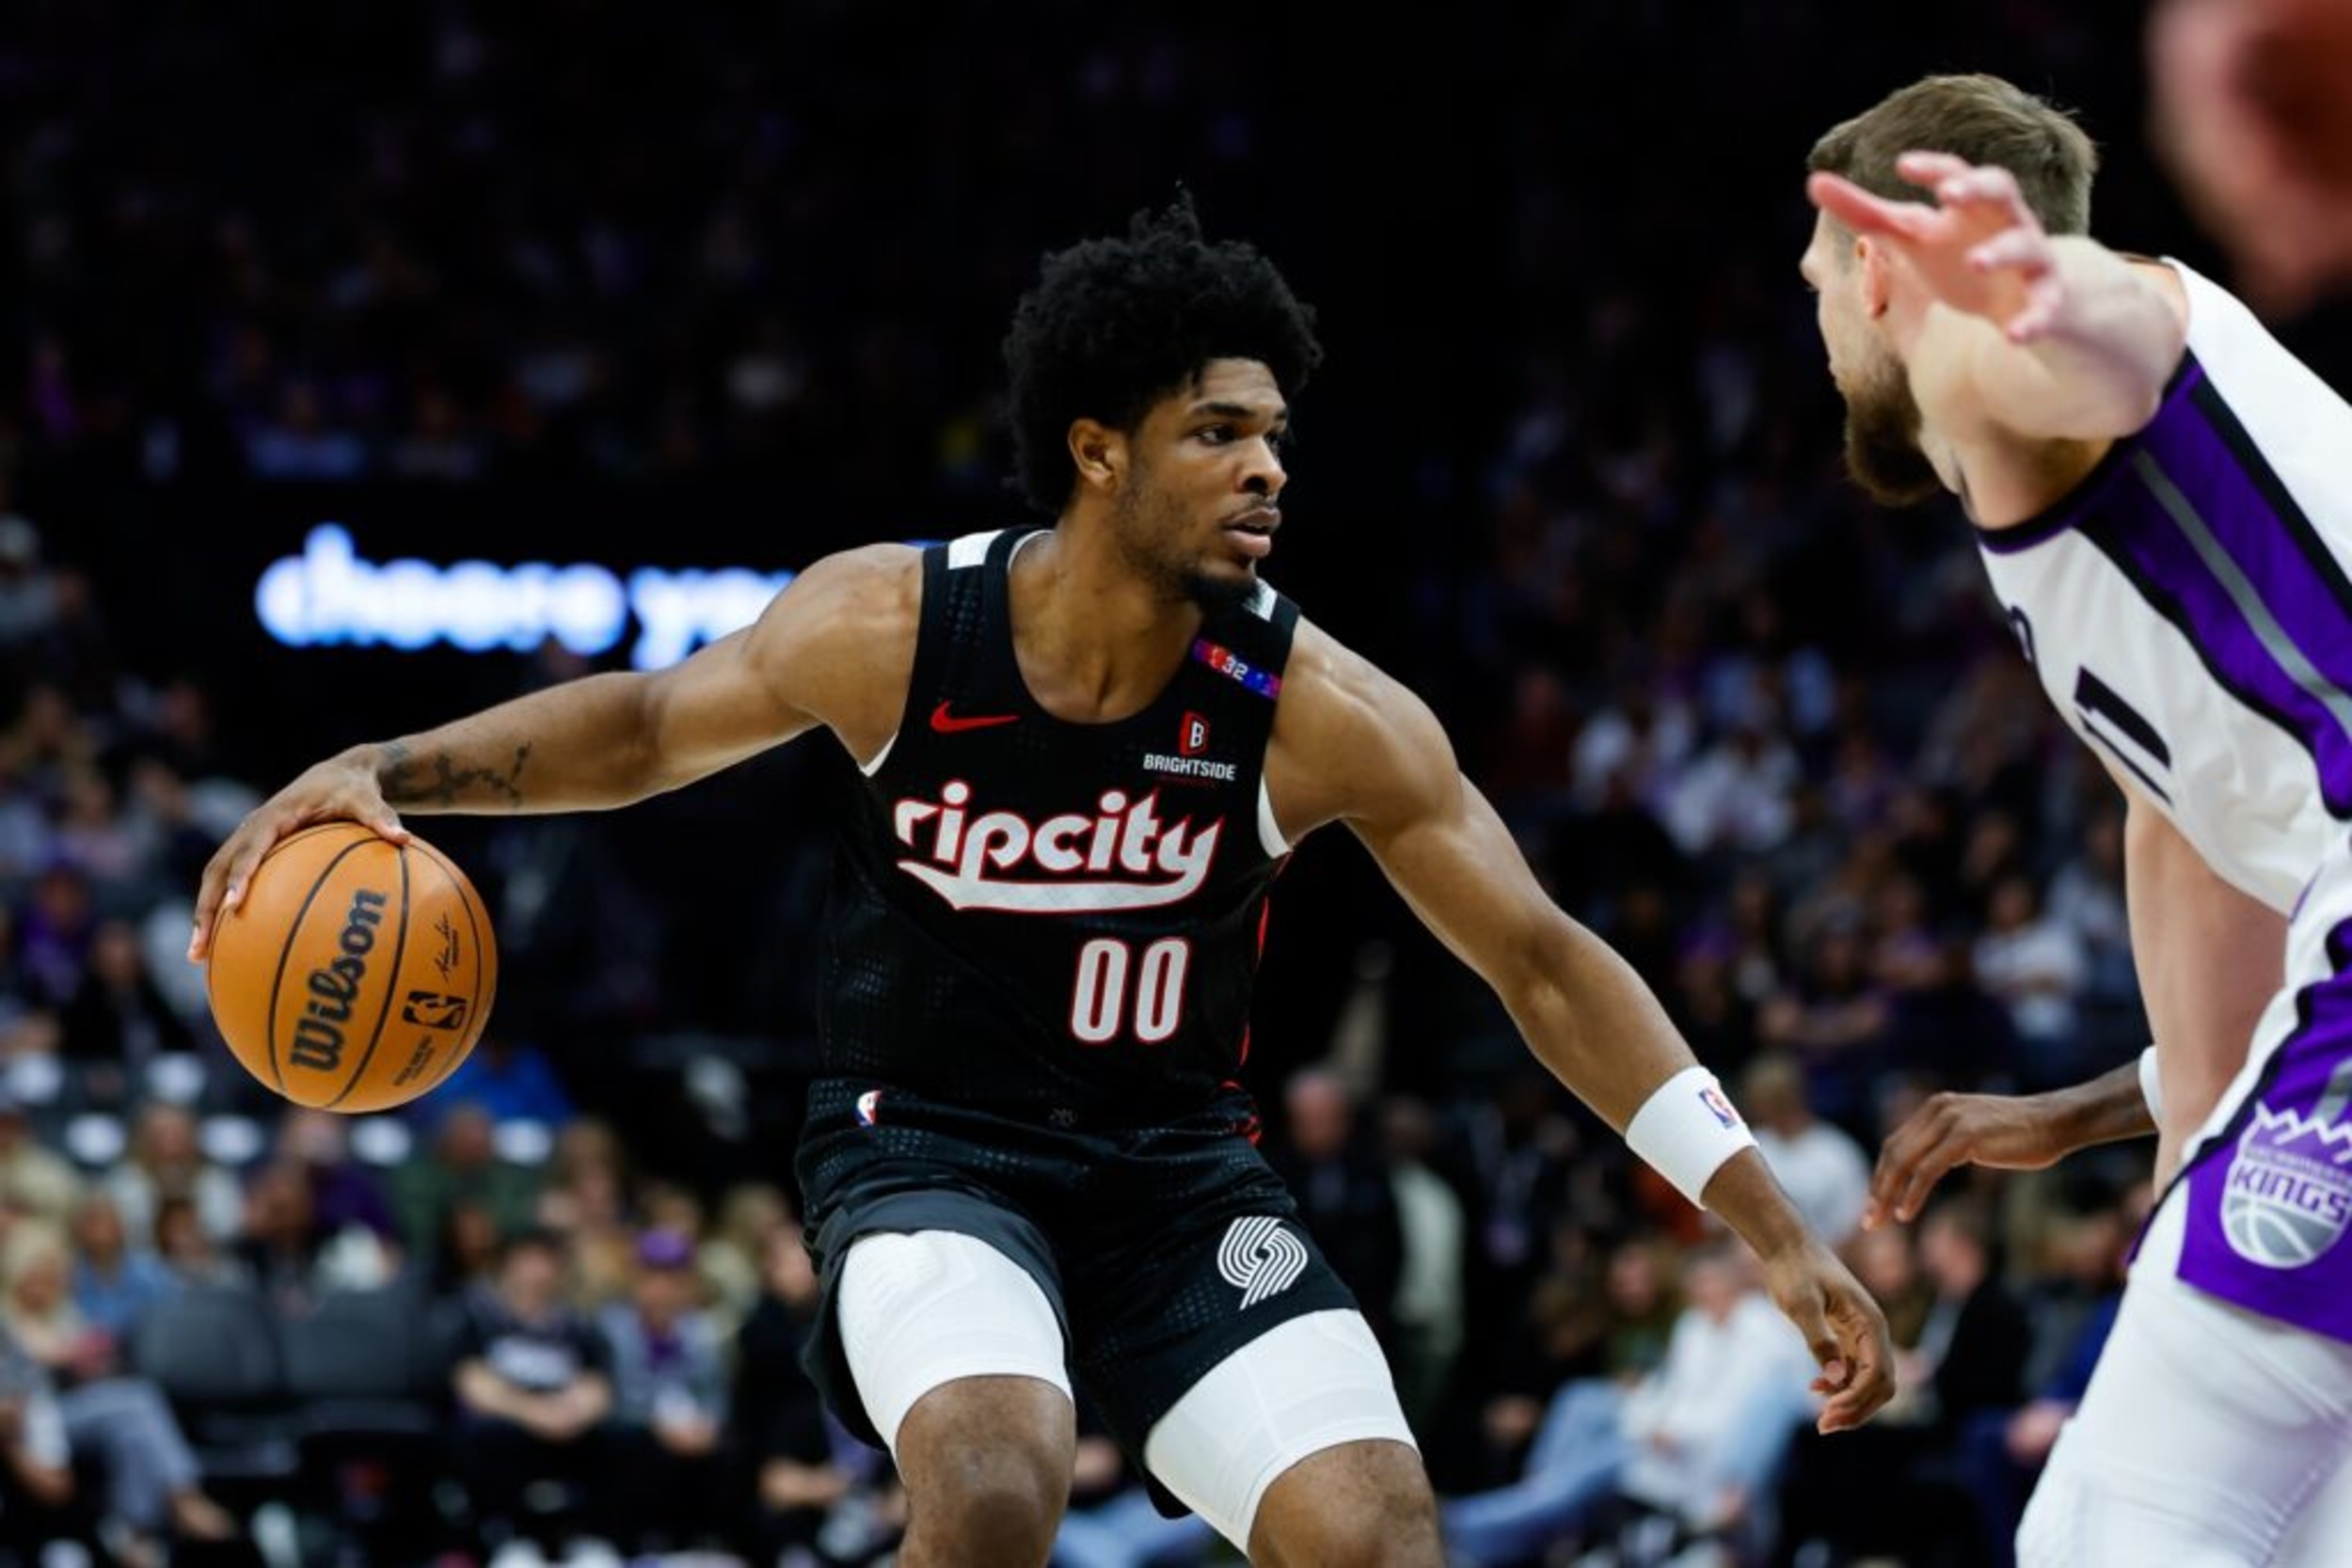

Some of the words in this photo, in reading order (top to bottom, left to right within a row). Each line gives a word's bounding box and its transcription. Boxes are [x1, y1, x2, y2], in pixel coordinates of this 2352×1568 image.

[1221, 655, 1249, 681] 32
[1142, 752, 1237, 782] BRIGHTSIDE
[895, 780, 1225, 913] ripcity
[290, 888, 388, 1071] Wilson
[1070, 936, 1191, 1043] 00
[2232, 1164, 2351, 1224] KINGS
